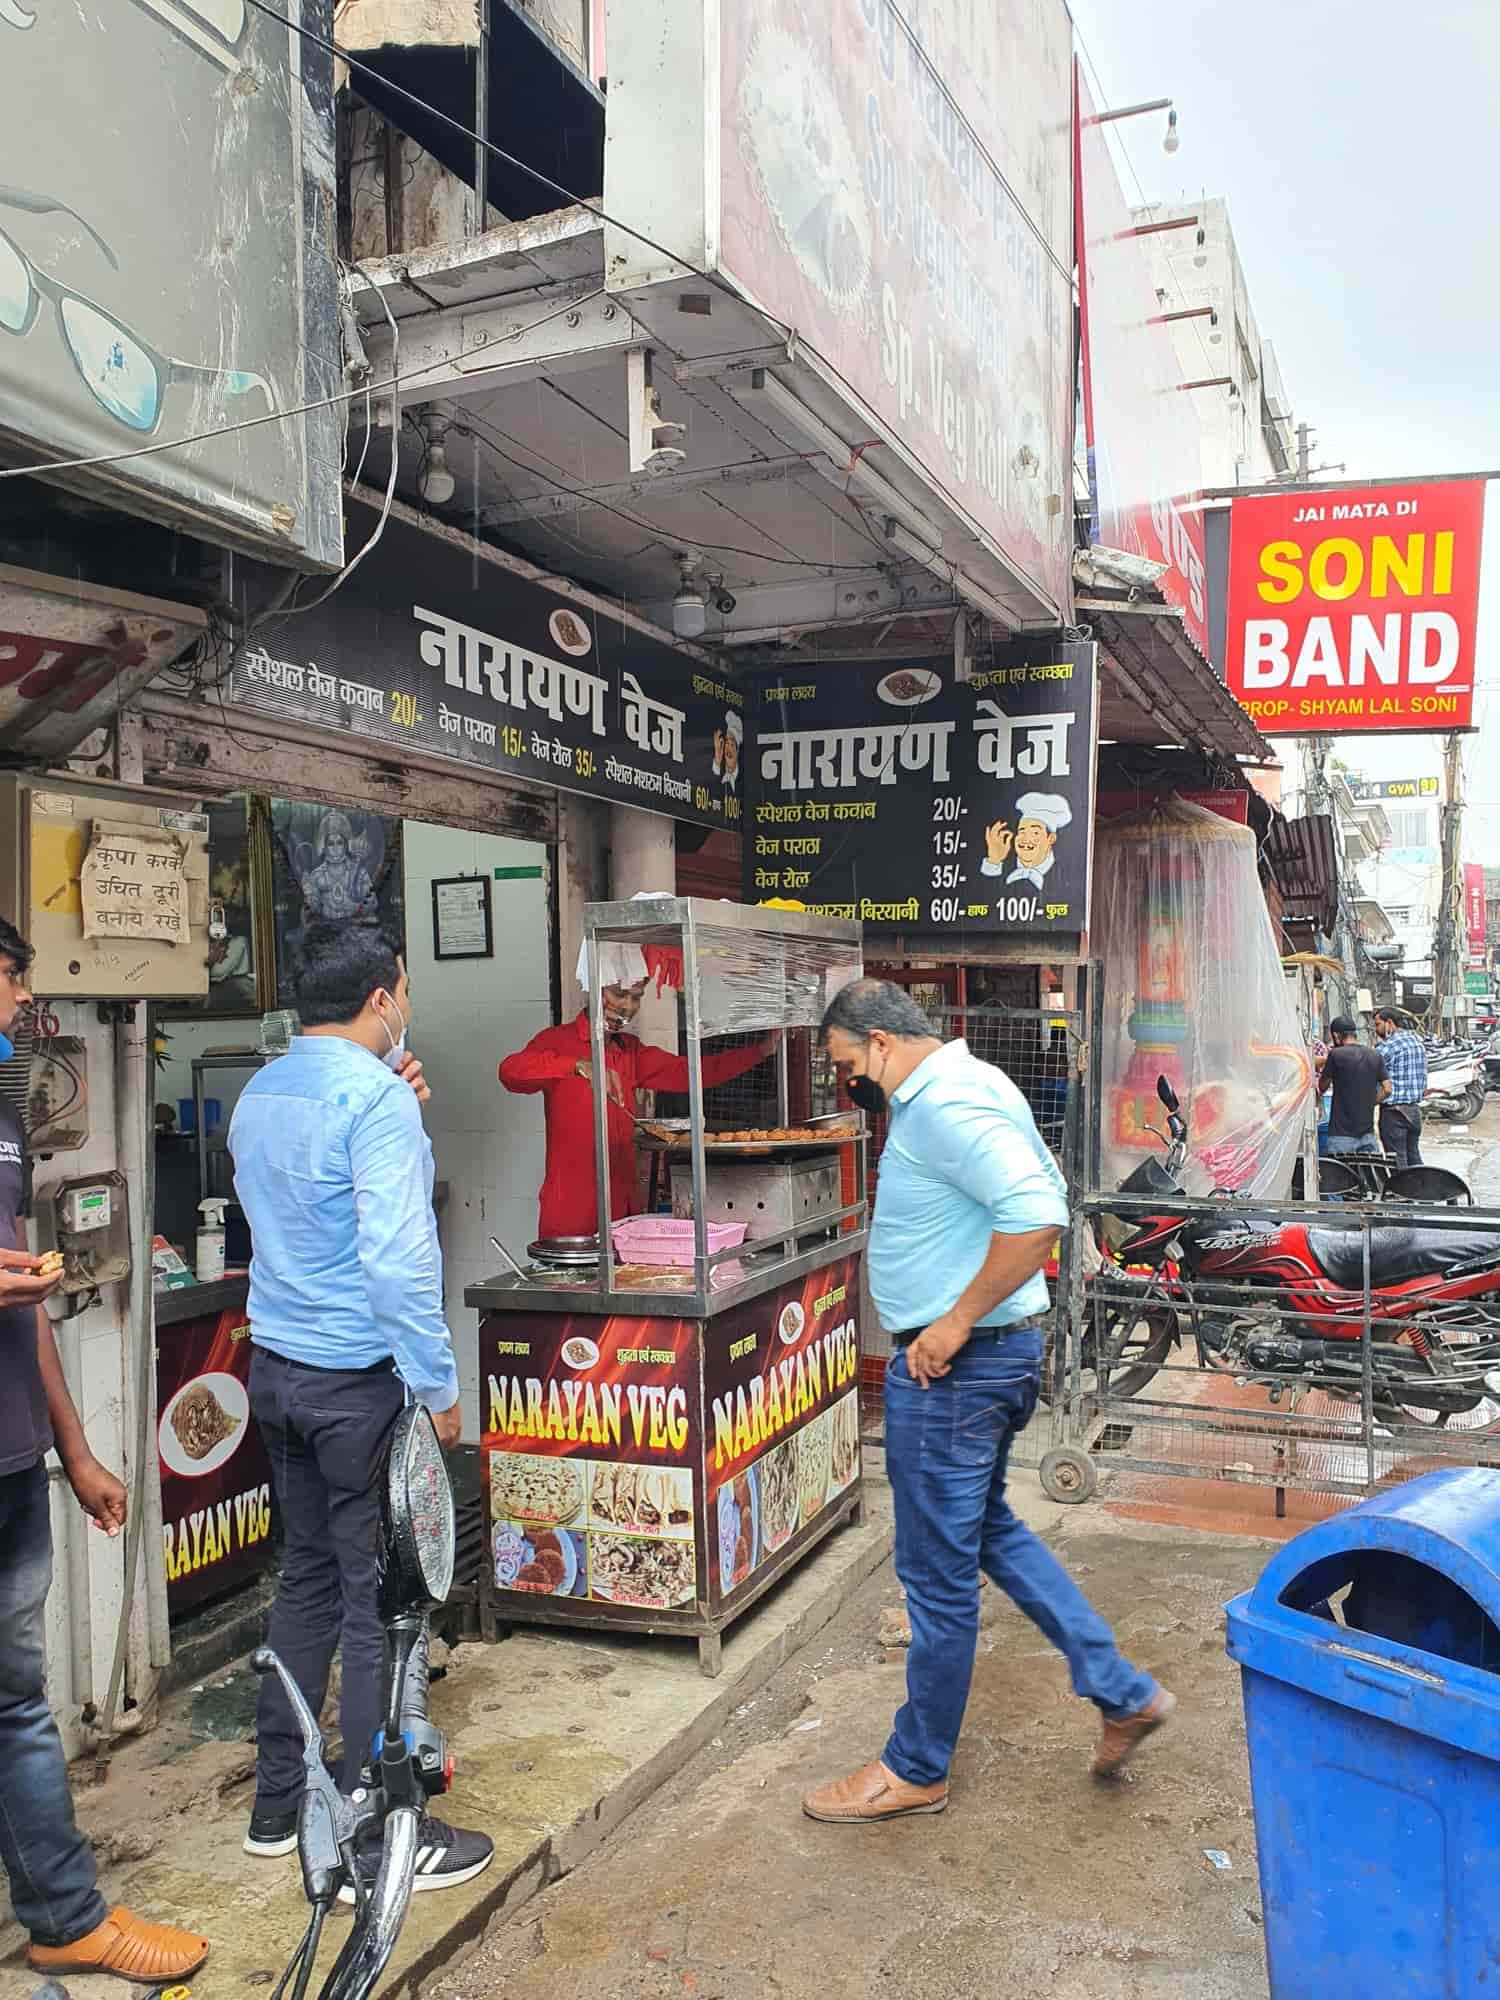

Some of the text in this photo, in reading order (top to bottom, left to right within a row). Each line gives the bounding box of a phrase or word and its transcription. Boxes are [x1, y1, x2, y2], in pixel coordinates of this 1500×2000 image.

[882, 281, 1008, 513] Sp. Veg Roll
[1293, 499, 1418, 524] JAI MATA DI
[1256, 531, 1455, 604] SONI
[413, 604, 686, 764] नारायण वेज
[1029, 663, 1074, 682] स्वच्छता
[1243, 611, 1460, 690] BAND
[245, 648, 305, 691] स्पेशल
[307, 662, 337, 700] वेज
[391, 690, 424, 728] 20/-
[1299, 698, 1363, 717] SHYAM
[1369, 698, 1404, 715] LAL
[1411, 695, 1457, 714] SONI
[438, 702, 461, 737] वेज
[463, 716, 497, 748] पराठा
[502, 725, 527, 758] 15/-
[531, 730, 551, 763] वेज
[552, 737, 573, 768] रोल
[575, 748, 597, 779] 35/-
[604, 755, 633, 785] स्पेशल
[695, 785, 712, 811] 60/-
[757, 700, 1075, 790] नारायण वेज
[755, 801, 803, 823] स्पेशल
[804, 799, 831, 821] वेज
[932, 797, 968, 821] 20/-
[755, 830, 967, 857] वेज पराठा 15/-
[96, 847, 137, 871] कृपा
[96, 876, 180, 905] उचित दूरी
[755, 864, 967, 889] वेज रोल 35/-
[860, 897, 920, 921] बिरयानी
[931, 898, 965, 922] 60/-
[996, 898, 1043, 922] 100/-
[1046, 903, 1069, 920] फुल
[487, 1374, 690, 1451] NARAYAN VEG
[711, 1318, 857, 1471] NARAYAN VEG
[234, 1482, 271, 1550] VEG
